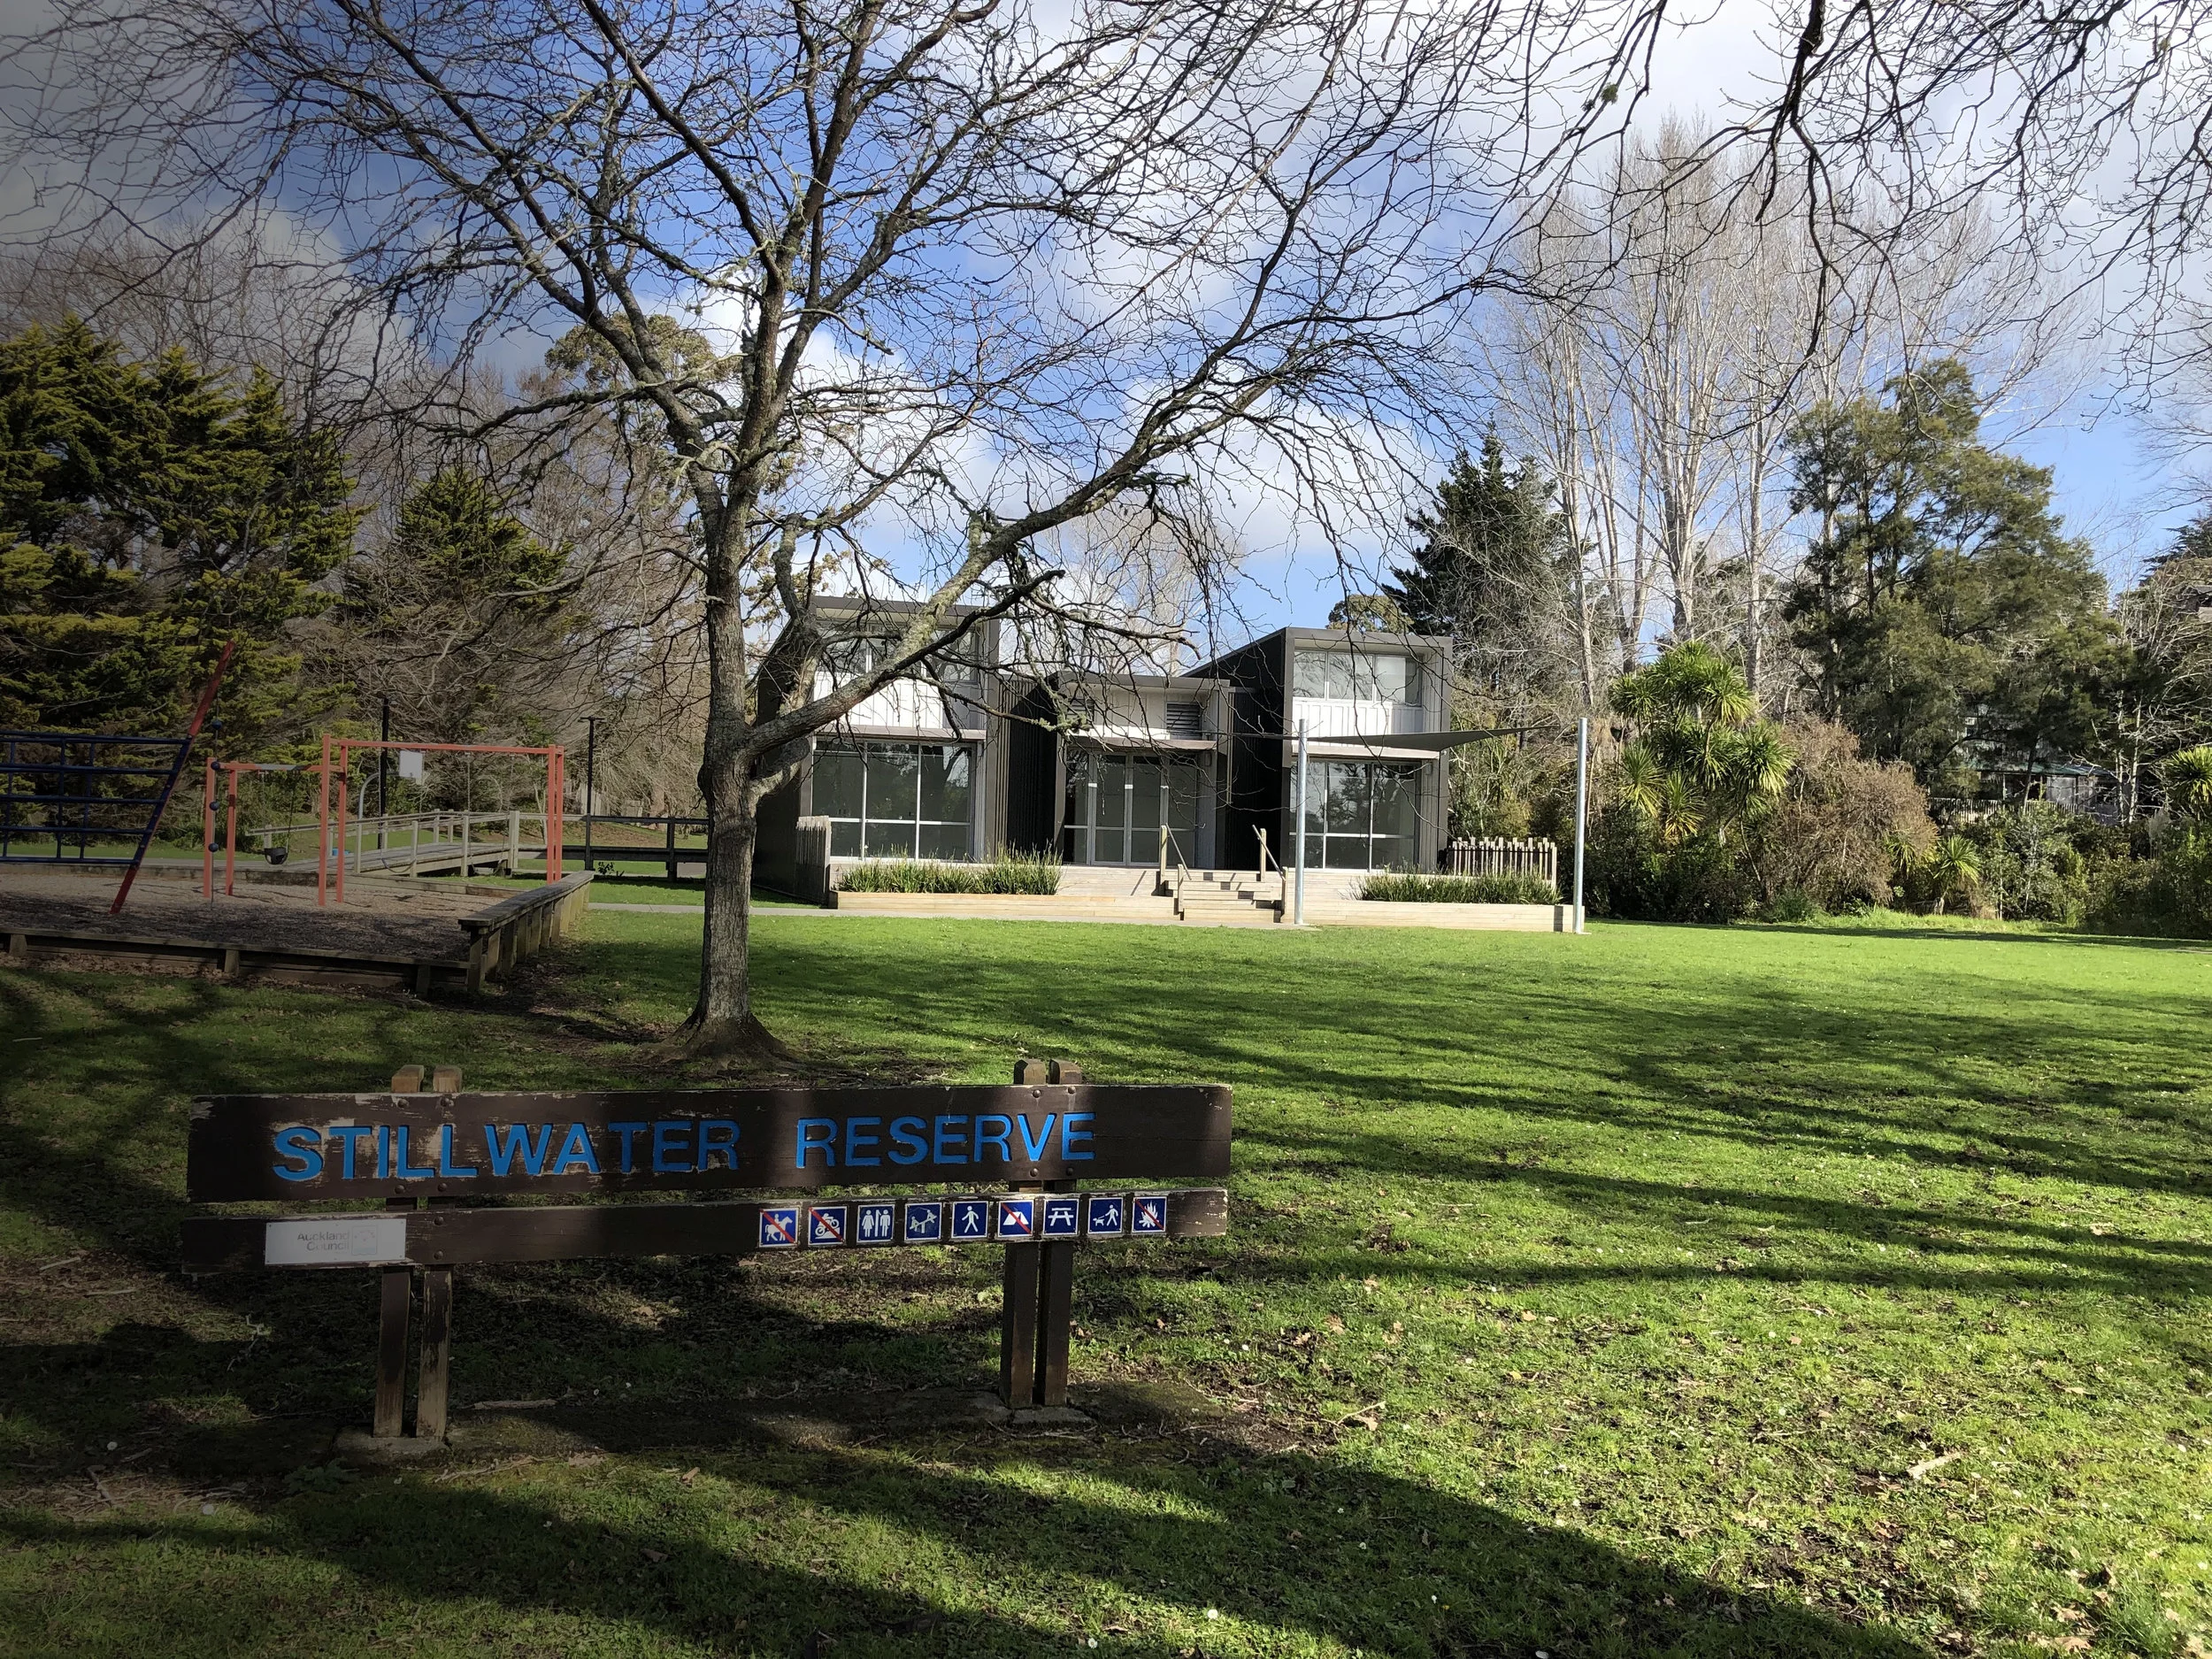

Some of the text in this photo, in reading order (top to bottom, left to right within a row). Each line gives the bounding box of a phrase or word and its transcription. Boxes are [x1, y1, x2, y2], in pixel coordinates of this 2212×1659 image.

[272, 1111, 1096, 1181] STILLWATER RESERVE
[297, 1229, 350, 1241] Auckland
[306, 1240, 350, 1251] Council
